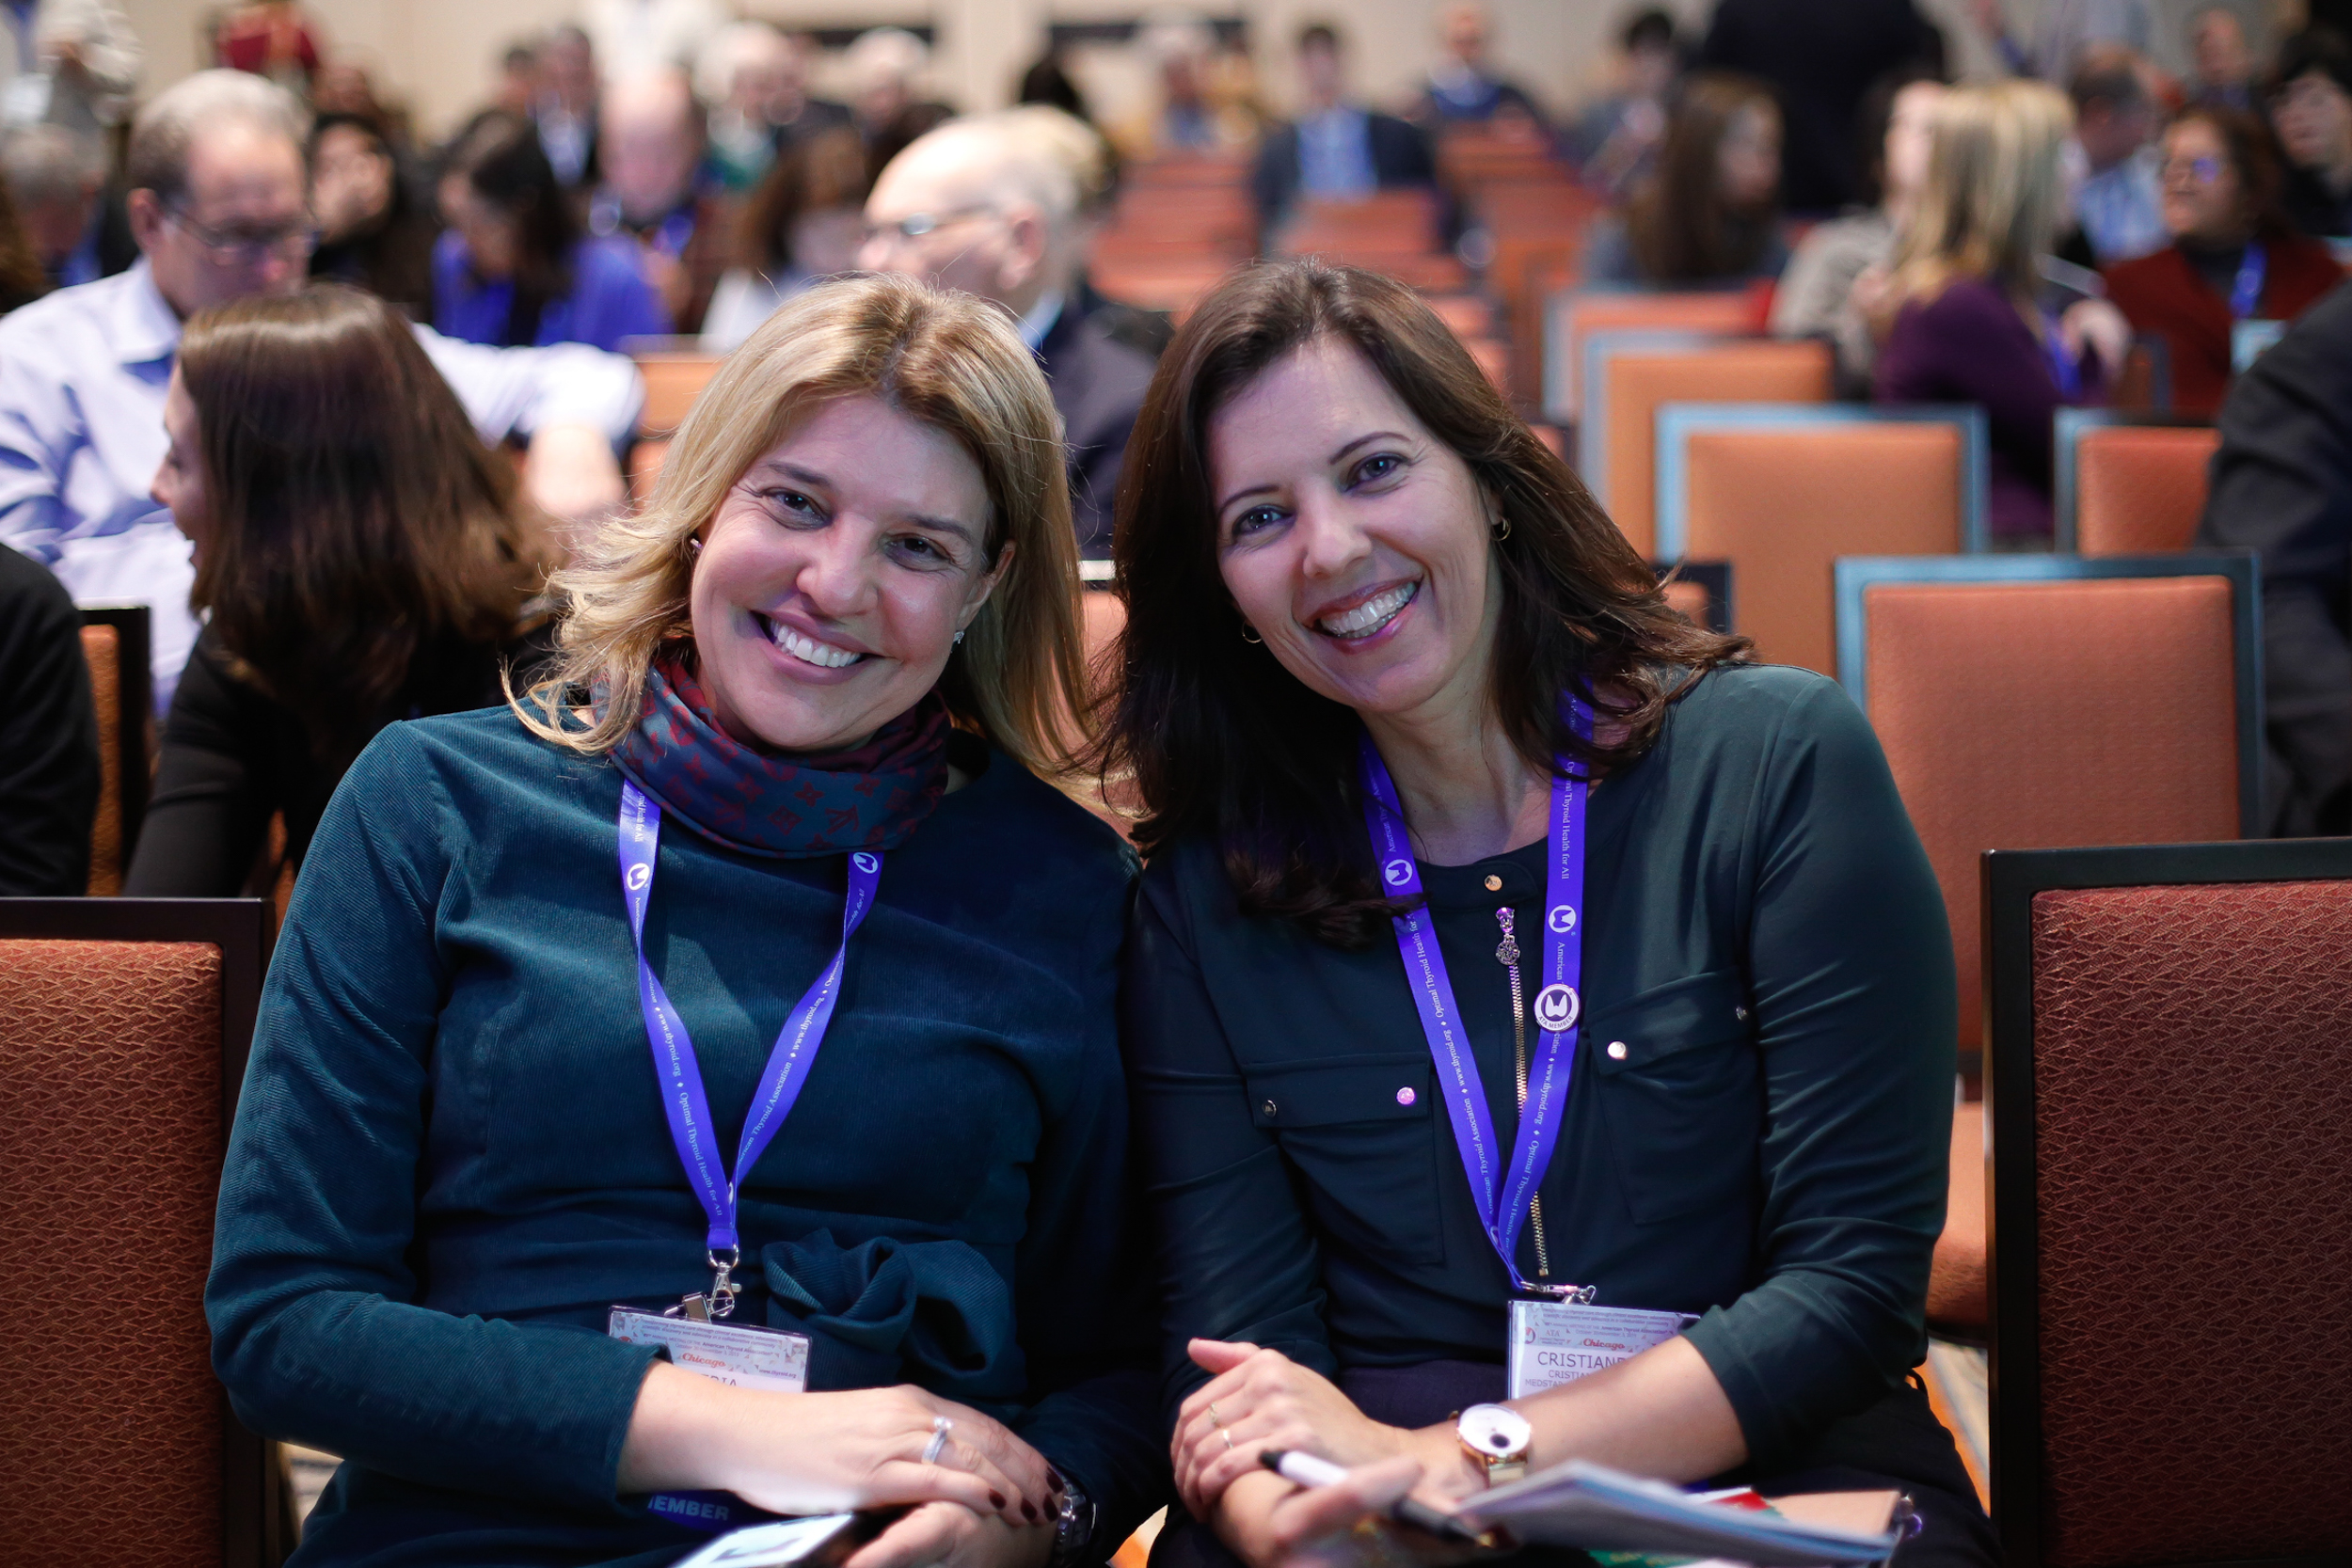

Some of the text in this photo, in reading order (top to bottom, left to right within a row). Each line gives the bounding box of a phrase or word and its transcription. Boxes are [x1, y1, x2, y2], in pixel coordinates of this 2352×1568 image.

[1562, 793, 1573, 824] Thyroid
[634, 832, 644, 842] All
[1562, 824, 1571, 852] Health
[1412, 932, 1427, 958] Health
[1556, 942, 1565, 980] American
[1419, 958, 1435, 988] Thyroid
[1428, 987, 1444, 1018] Optimal
[792, 997, 825, 1051] www.thyroid.org
[1548, 1015, 1573, 1028] MEMBER
[659, 1013, 682, 1077] www.thyroid.org
[1443, 1029, 1466, 1087] www.thyroid.org
[751, 1105, 773, 1135] Thyroid
[769, 1062, 792, 1107] Association
[1534, 1064, 1553, 1125] www.thyroid.org
[679, 1092, 695, 1126] Optimal
[688, 1126, 704, 1161] Thyroid
[698, 1161, 713, 1188] Health
[714, 1203, 723, 1216] All
[1464, 1098, 1494, 1215] American Thyroid Association
[1524, 1140, 1539, 1174] Optimal
[1513, 1174, 1530, 1207] Thyroid
[682, 1352, 727, 1369] Chicago
[1583, 1338, 1625, 1351] Chicago
[647, 1495, 730, 1521] EMBER
